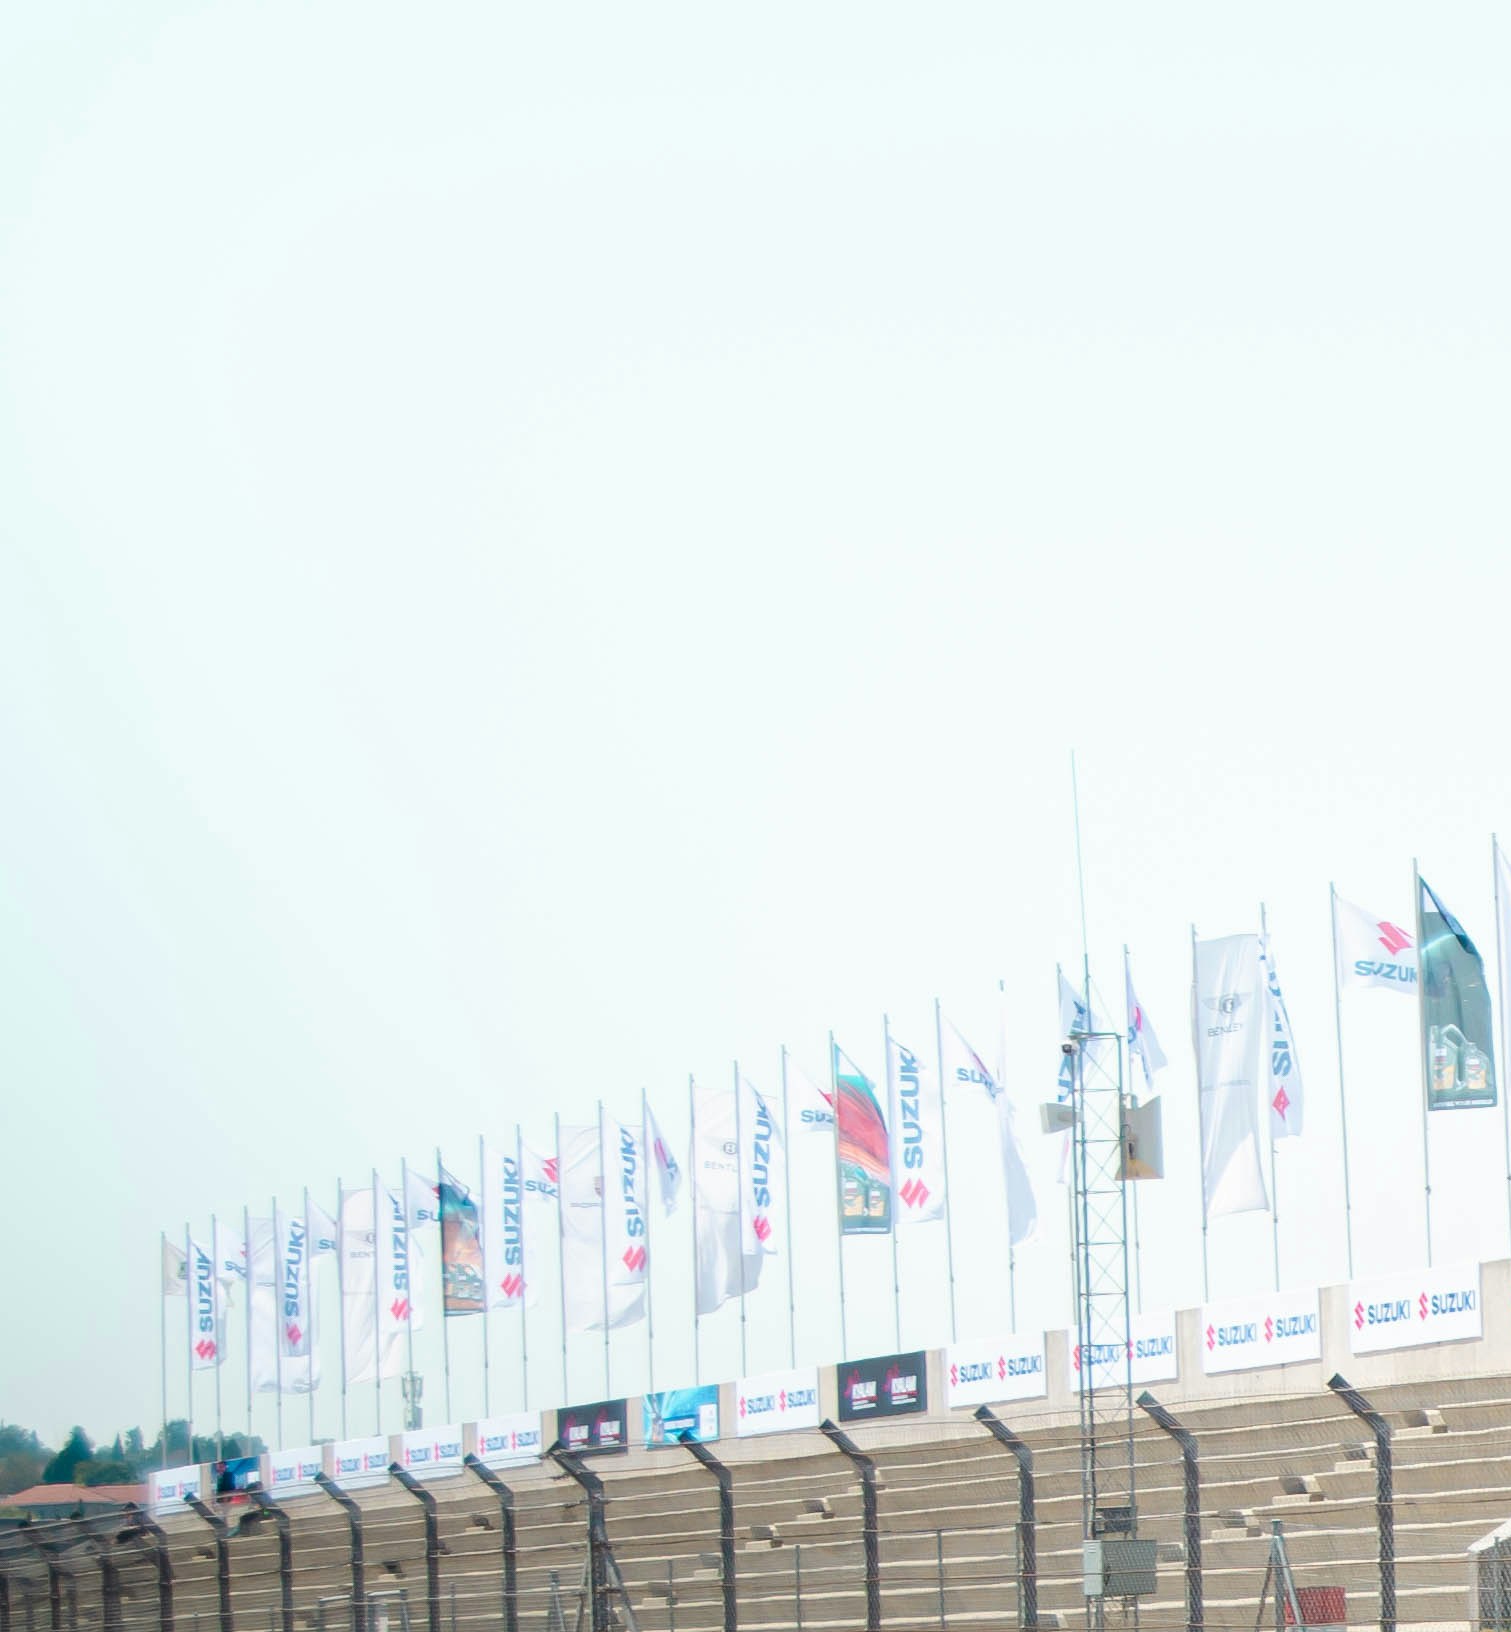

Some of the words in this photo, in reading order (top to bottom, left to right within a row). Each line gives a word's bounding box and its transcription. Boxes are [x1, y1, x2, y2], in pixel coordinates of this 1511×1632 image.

[899, 1050, 924, 1170] SUZUK
[1367, 1299, 1411, 1325] SUZUKI
[1431, 1288, 1477, 1316] SUZUKI
[1217, 1322, 1257, 1347] SUZUKI
[1276, 1313, 1317, 1339] SUZUKI
